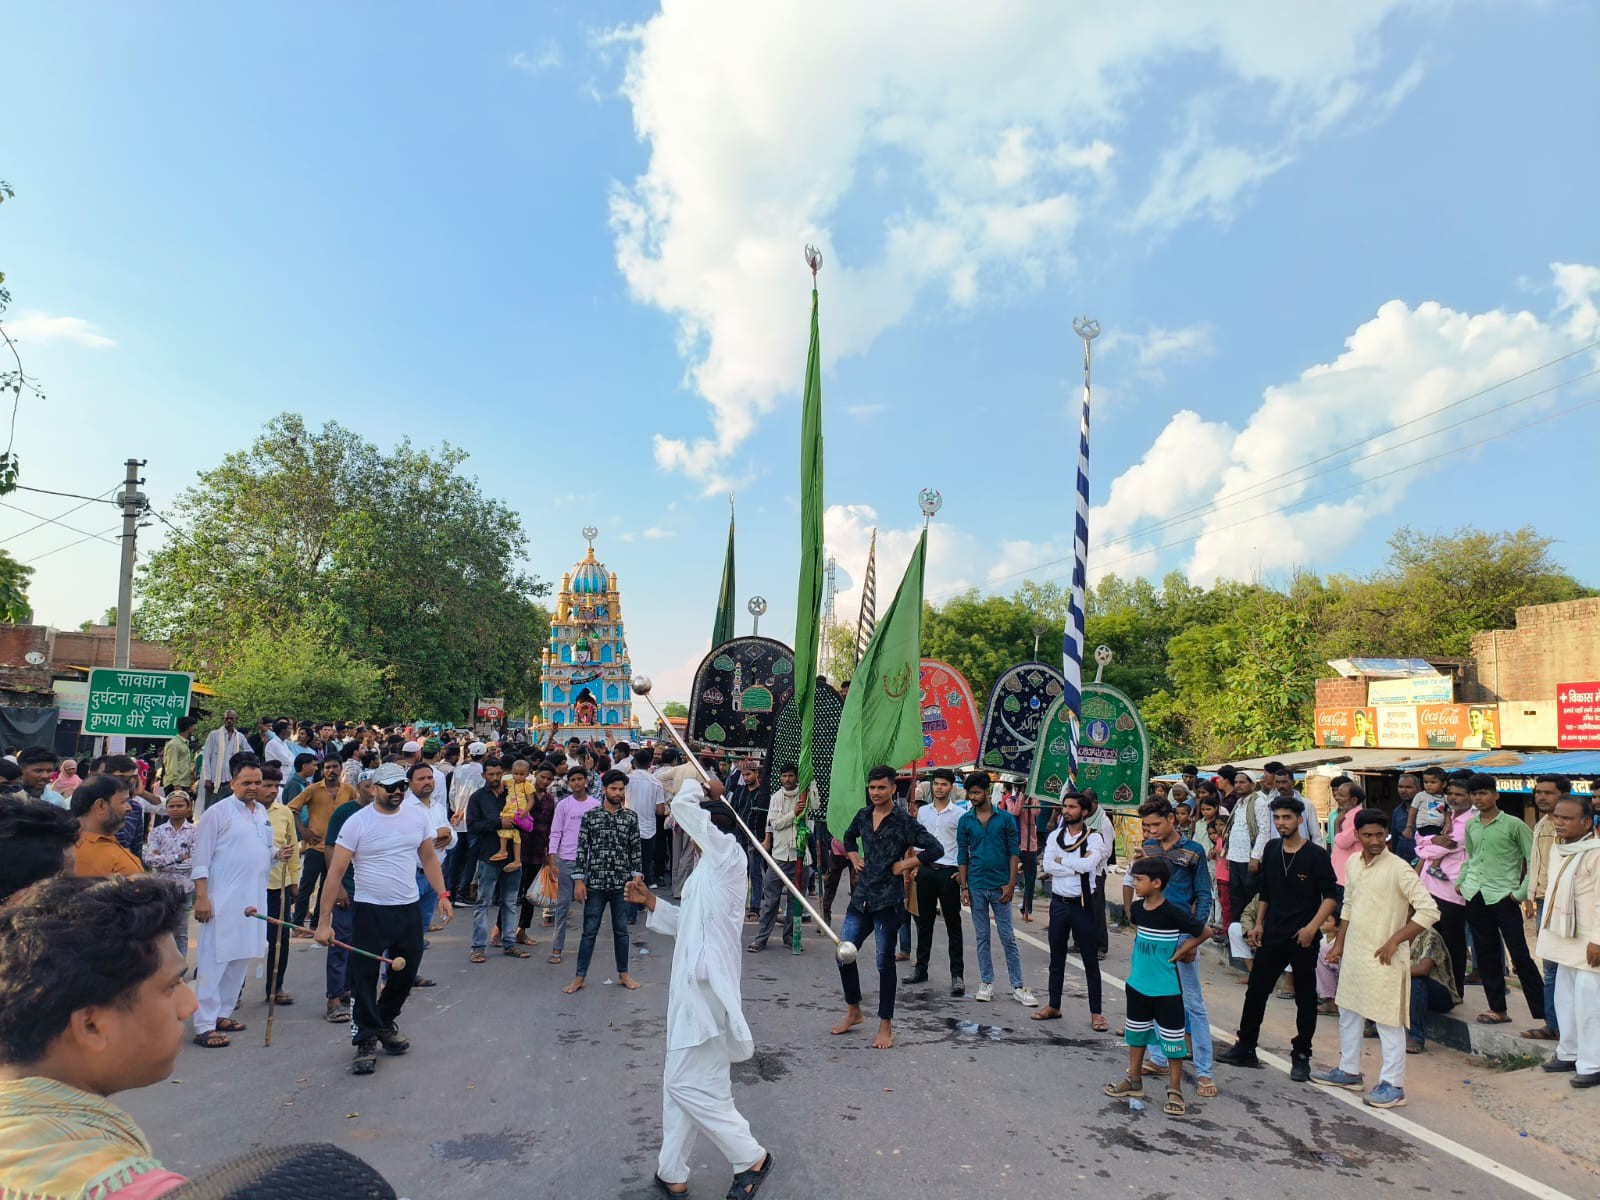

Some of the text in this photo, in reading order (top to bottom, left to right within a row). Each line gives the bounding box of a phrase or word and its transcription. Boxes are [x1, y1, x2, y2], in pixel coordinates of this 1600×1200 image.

[117, 673, 167, 688] सावधान
[91, 686, 130, 709] दुर्घटना
[133, 693, 166, 712] बाहुल्य
[166, 690, 185, 709] क्षेत्र
[1568, 689, 1593, 703] विकास
[90, 713, 121, 730] कृपया
[126, 709, 145, 728] धीरे
[1570, 777, 1594, 793] स्टो
